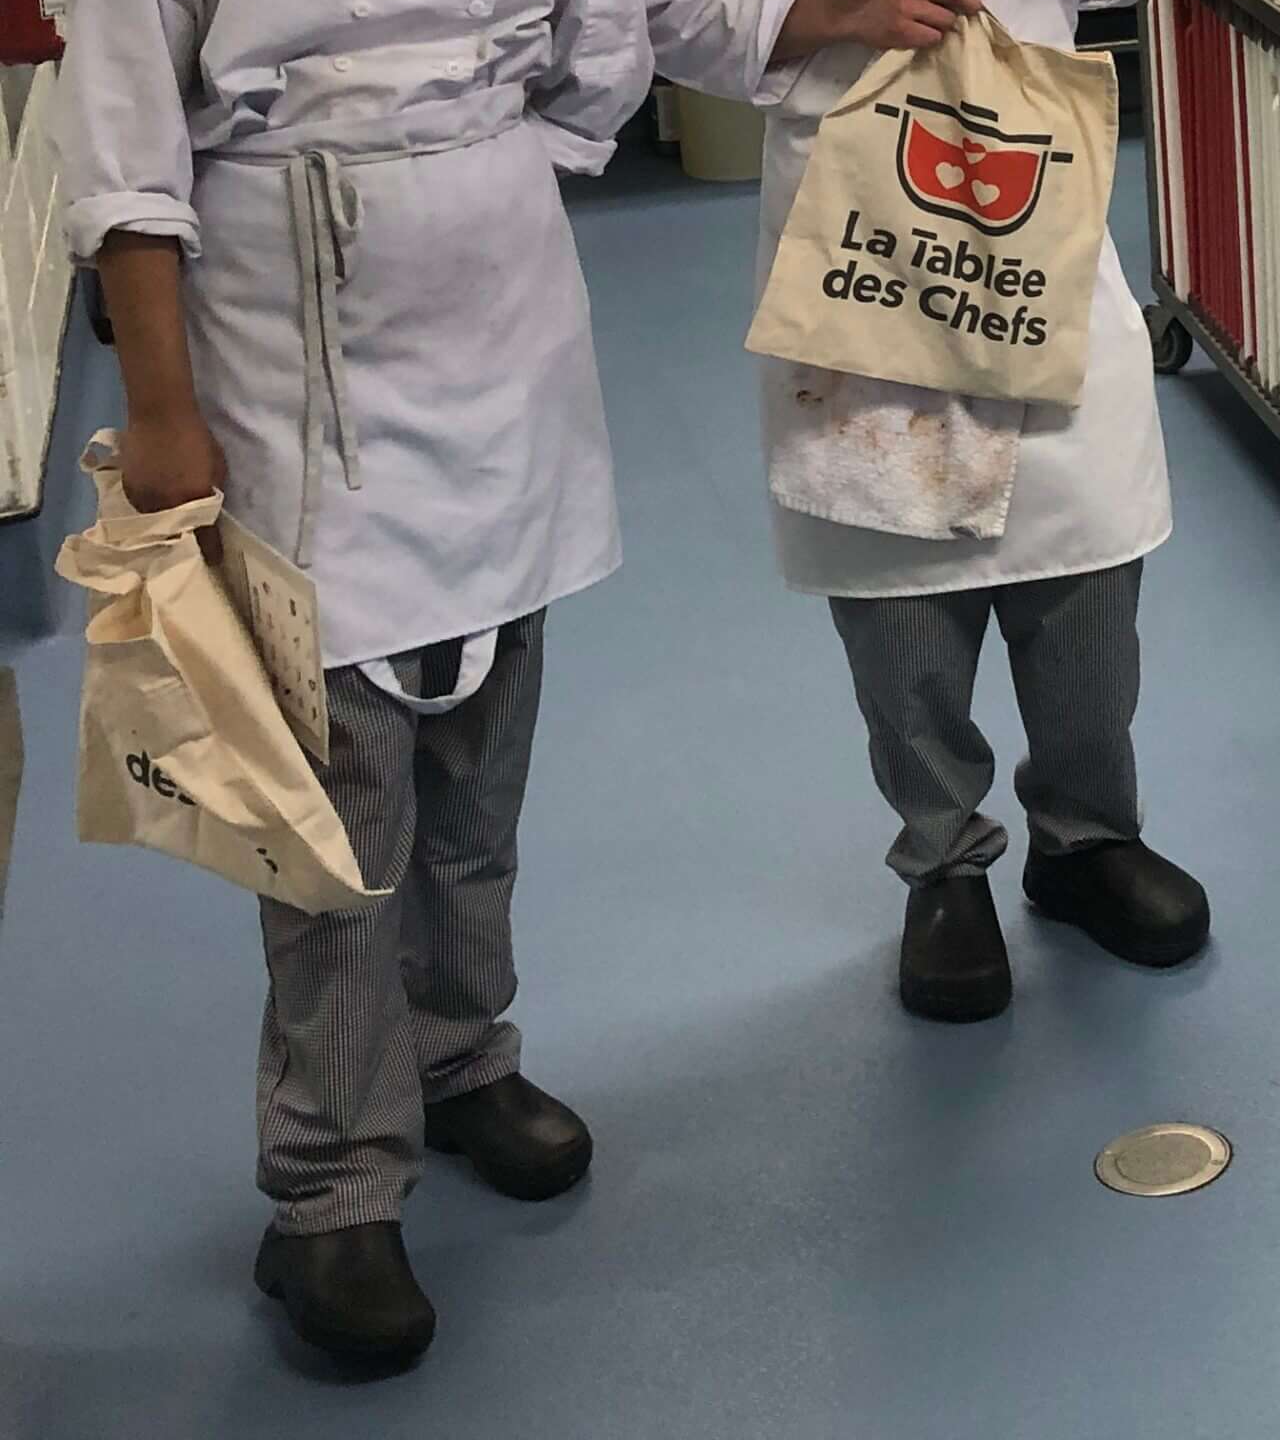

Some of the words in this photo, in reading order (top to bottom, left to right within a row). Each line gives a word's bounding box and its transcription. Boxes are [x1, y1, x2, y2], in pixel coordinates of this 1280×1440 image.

[840, 209, 898, 259] La
[822, 259, 909, 308] des
[918, 284, 1048, 347] Chefs
